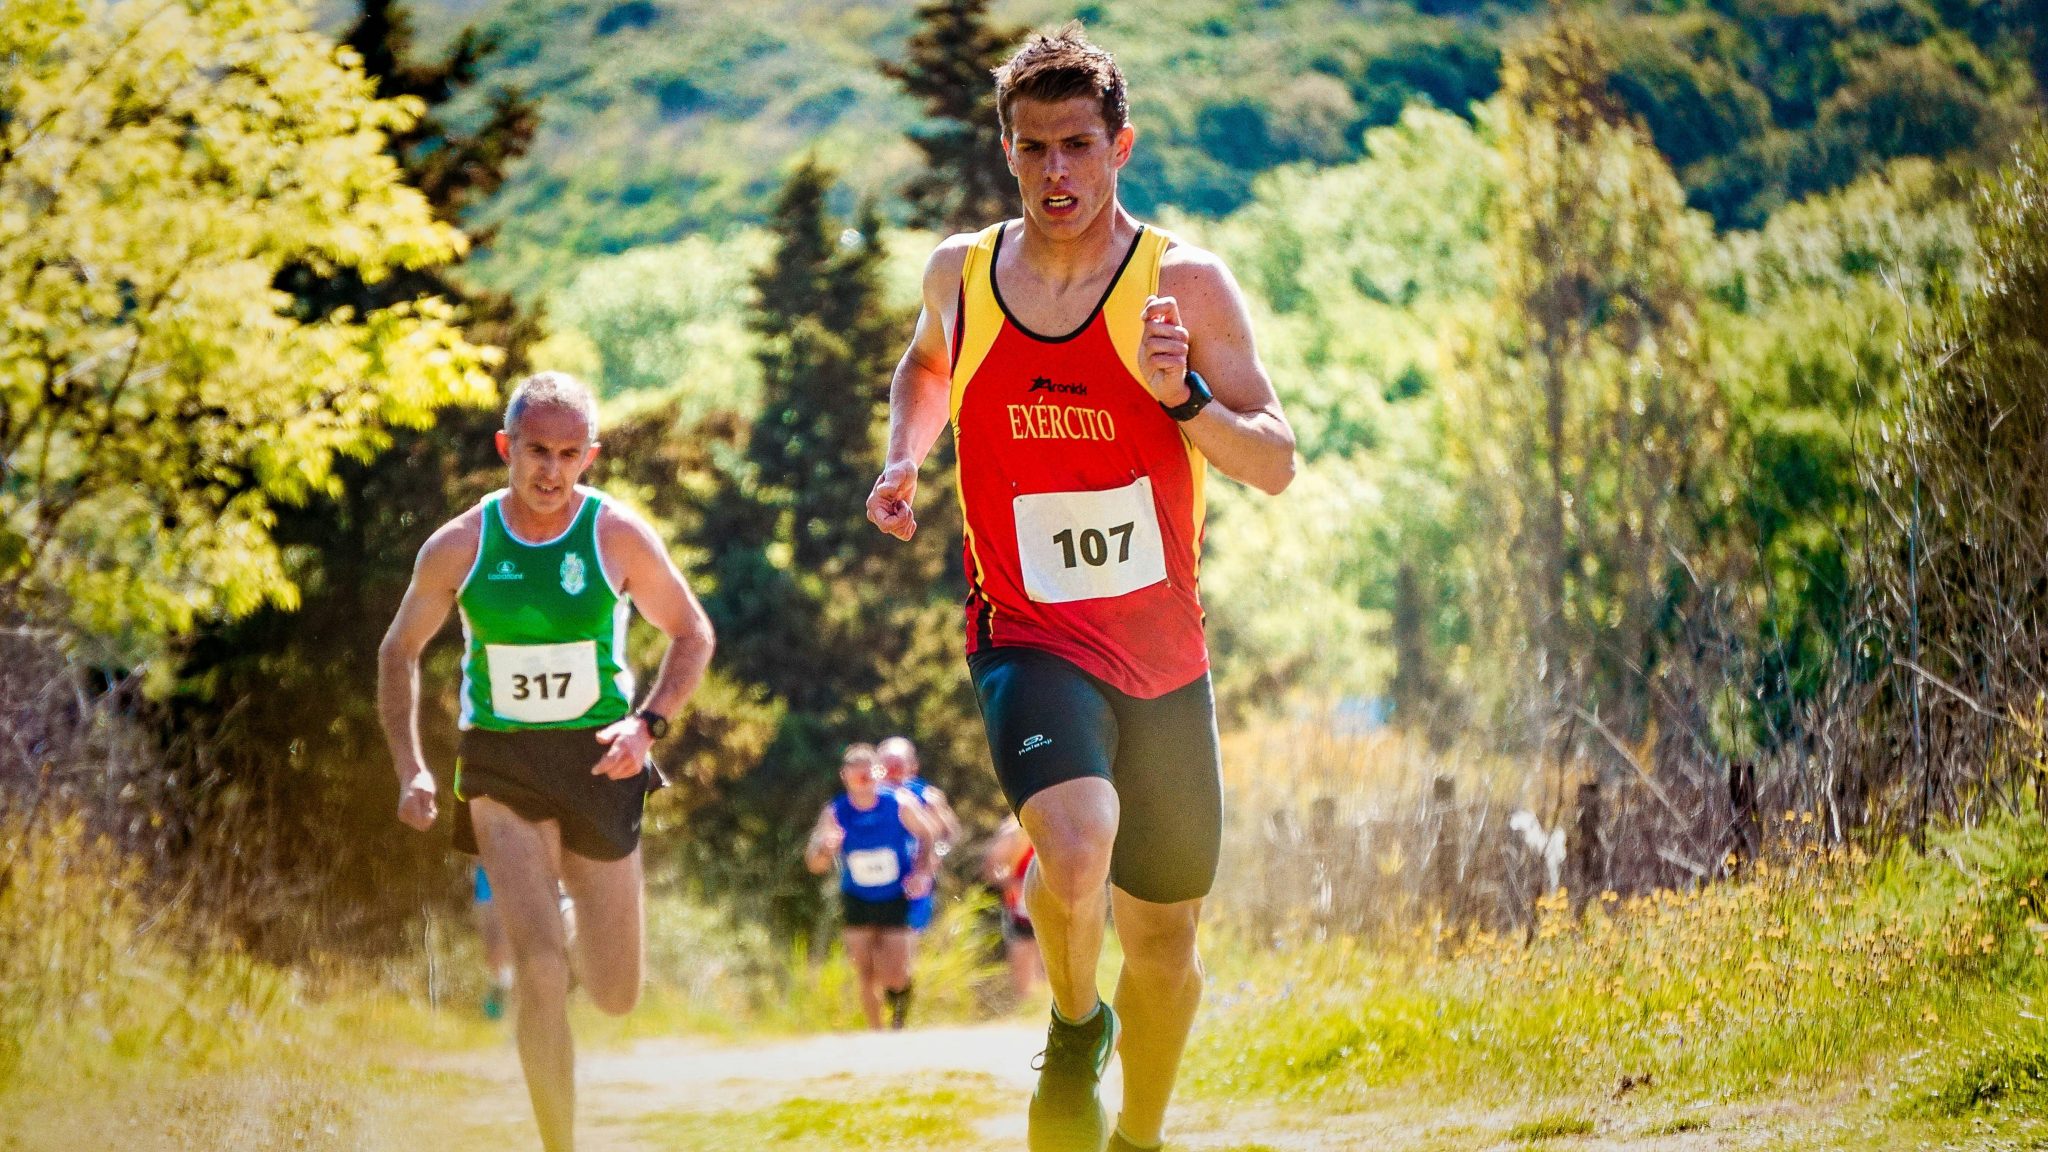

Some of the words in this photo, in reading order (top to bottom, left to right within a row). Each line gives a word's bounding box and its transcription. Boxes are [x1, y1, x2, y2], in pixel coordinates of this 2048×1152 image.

[1007, 396, 1116, 441] EXÉRCITO
[1052, 521, 1135, 568] 107
[511, 671, 572, 701] 317
